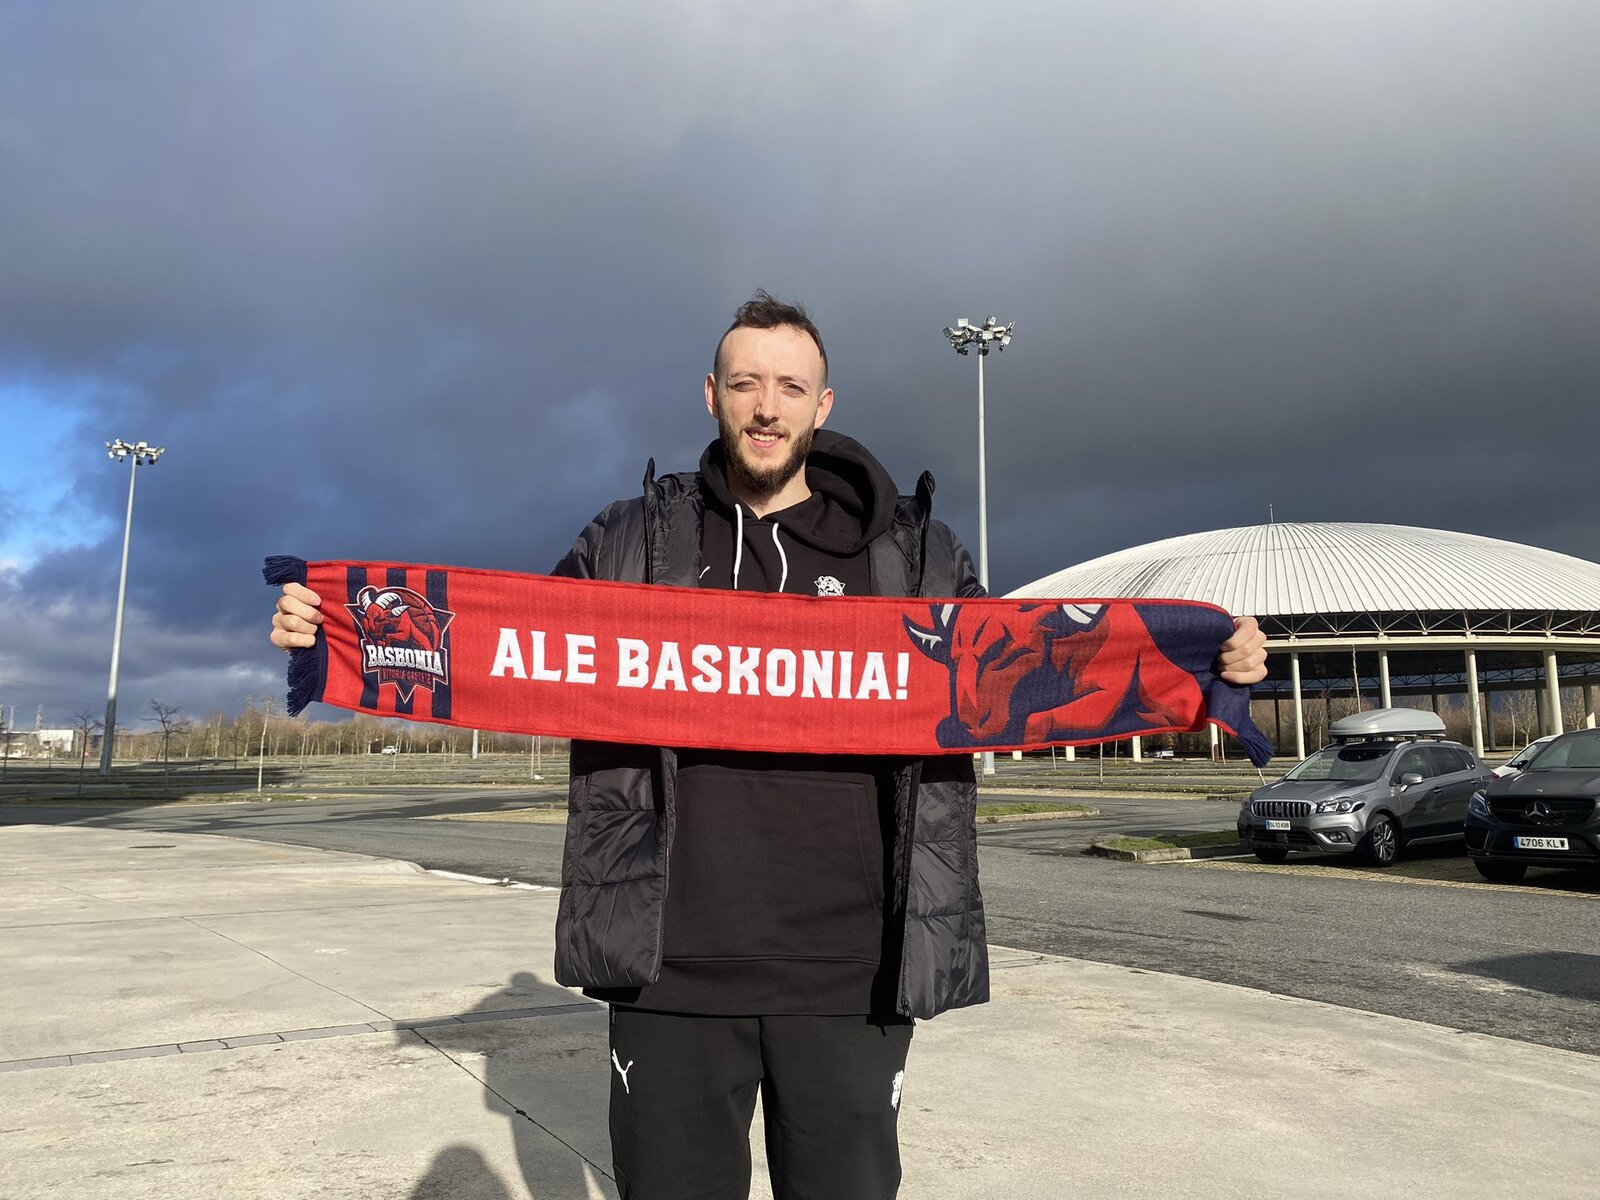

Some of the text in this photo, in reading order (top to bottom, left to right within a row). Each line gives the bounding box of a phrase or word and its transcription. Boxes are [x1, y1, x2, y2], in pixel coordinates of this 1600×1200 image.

[365, 644, 444, 676] BASKONIA
[489, 627, 910, 700] ALE BASKONIA!
[1520, 838, 1544, 848] 4706
